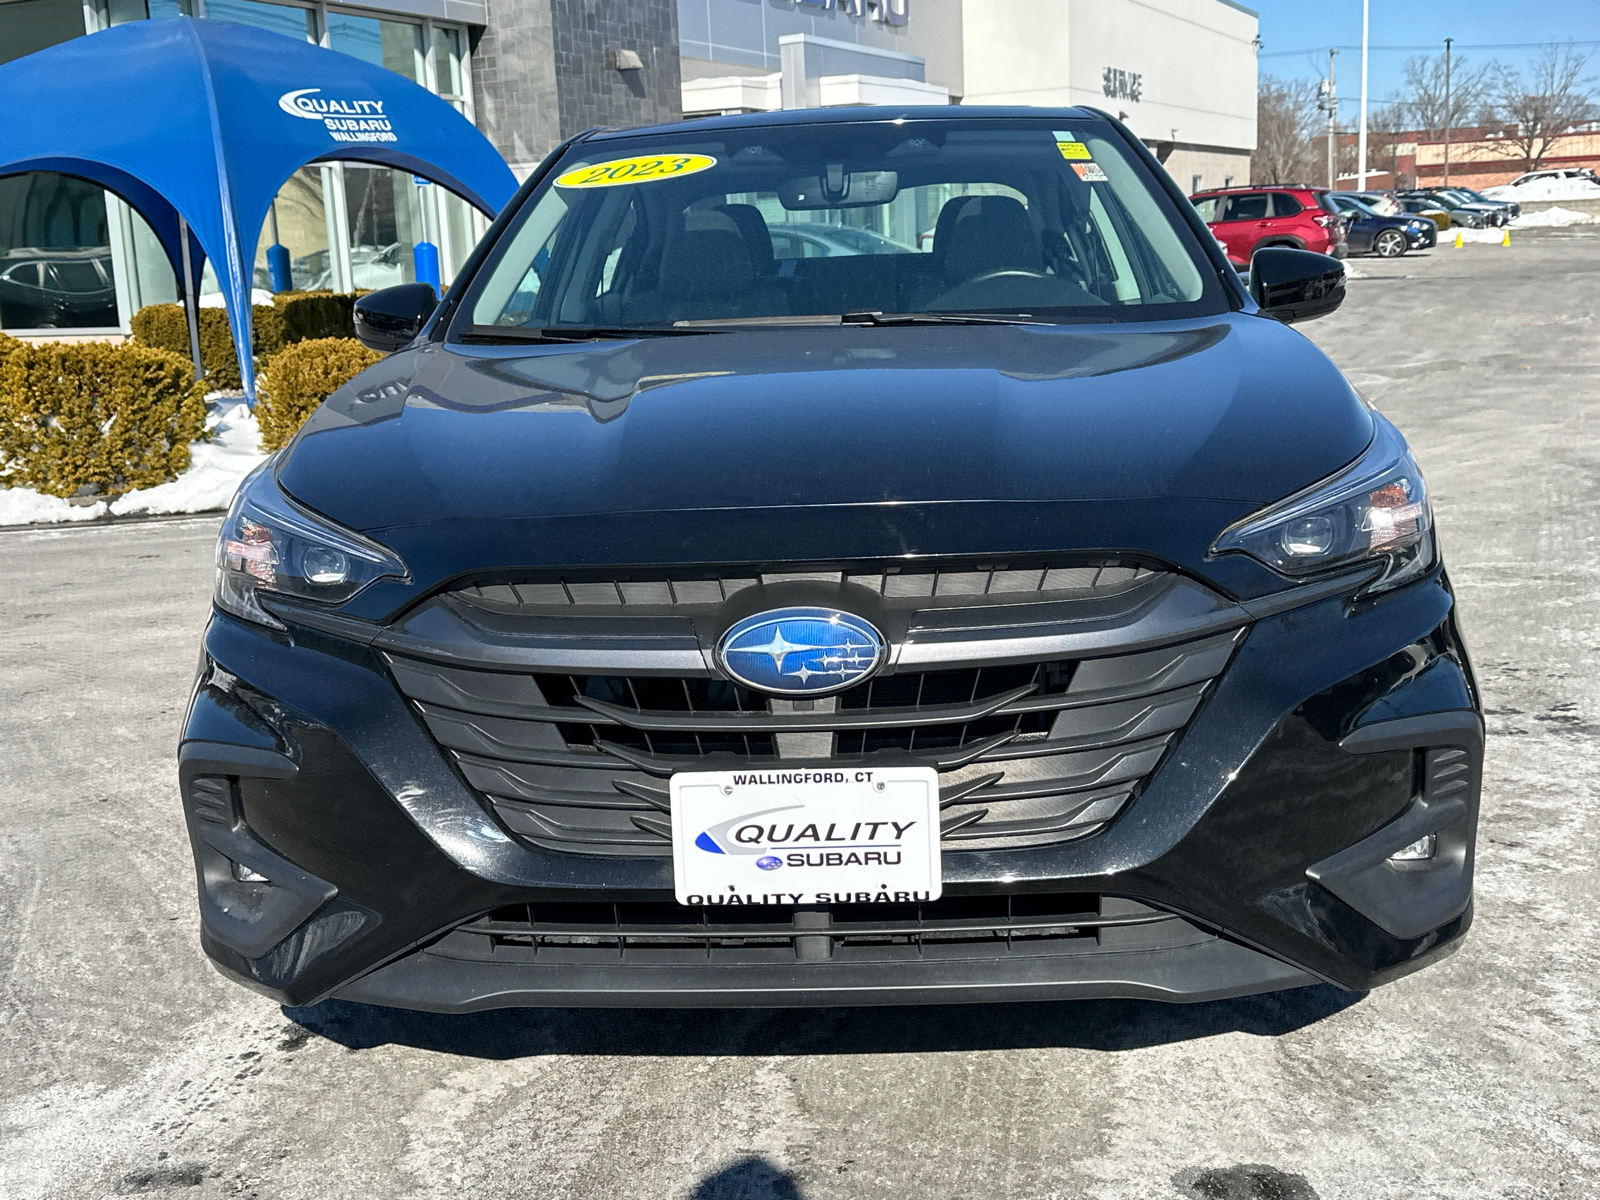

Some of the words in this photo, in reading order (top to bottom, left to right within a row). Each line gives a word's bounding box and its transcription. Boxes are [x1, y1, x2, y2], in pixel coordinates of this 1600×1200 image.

[297, 97, 383, 114] QUALITY
[324, 118, 392, 131] SUBARU
[329, 131, 398, 142] WALLINGFORD
[578, 157, 691, 184] 2023
[733, 773, 849, 785] WALLINGFORD,
[854, 772, 874, 783] CT
[734, 820, 918, 844] QUALITY
[786, 851, 902, 867] SUBARU
[686, 893, 804, 905] QUALITY
[815, 890, 930, 904] SUBARU
